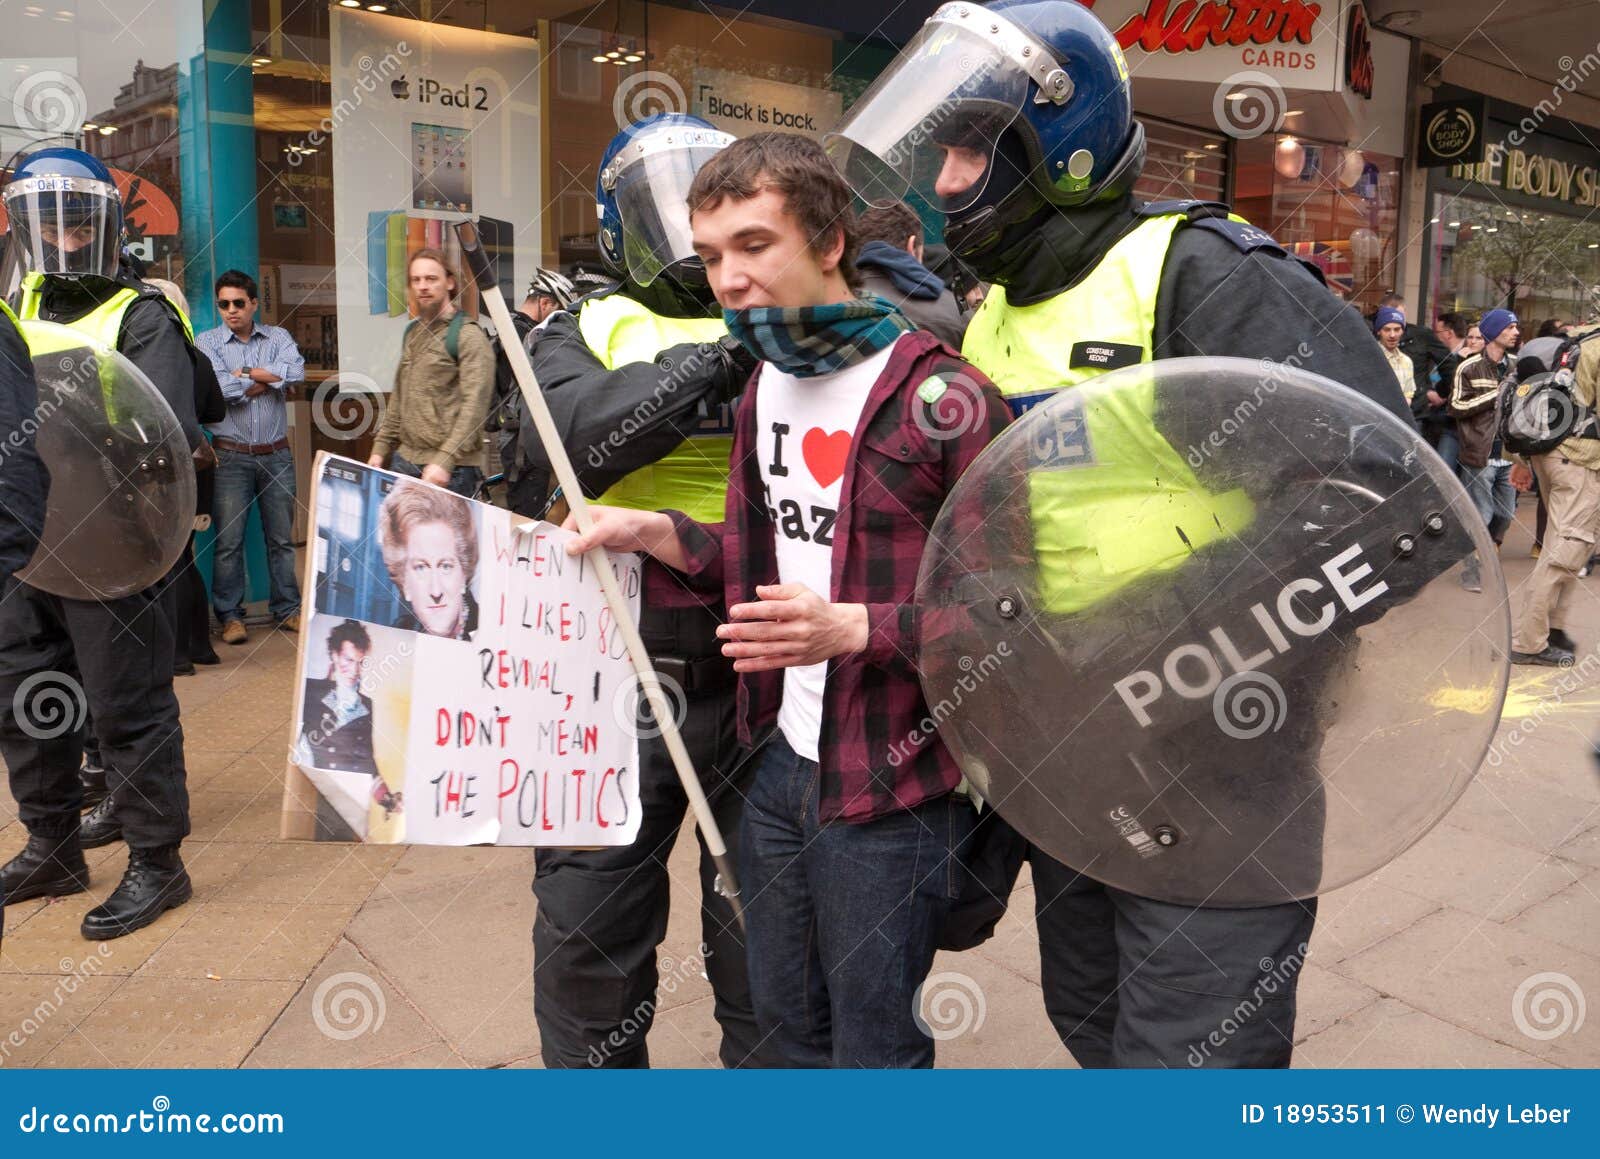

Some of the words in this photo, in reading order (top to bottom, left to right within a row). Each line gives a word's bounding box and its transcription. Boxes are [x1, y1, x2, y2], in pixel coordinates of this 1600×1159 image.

[1242, 48, 1316, 70] CARDS
[418, 77, 469, 108] iPad
[474, 86, 488, 111] 2
[708, 96, 753, 121] Black
[757, 105, 769, 124] is
[772, 108, 817, 131] back.
[1435, 129, 1466, 141] BODY
[1437, 138, 1464, 150] SHOP
[1506, 149, 1577, 201] BODY
[769, 421, 790, 477] I
[763, 484, 837, 547] az
[493, 525, 564, 577] WHEN
[499, 592, 505, 627] I
[521, 595, 587, 642] LIKED
[1112, 542, 1390, 728] POLICE
[593, 671, 601, 703] I
[435, 705, 511, 749] DIDN'T
[537, 718, 599, 756] MEAN
[430, 770, 478, 819] THE
[497, 758, 629, 831] POLITICS
